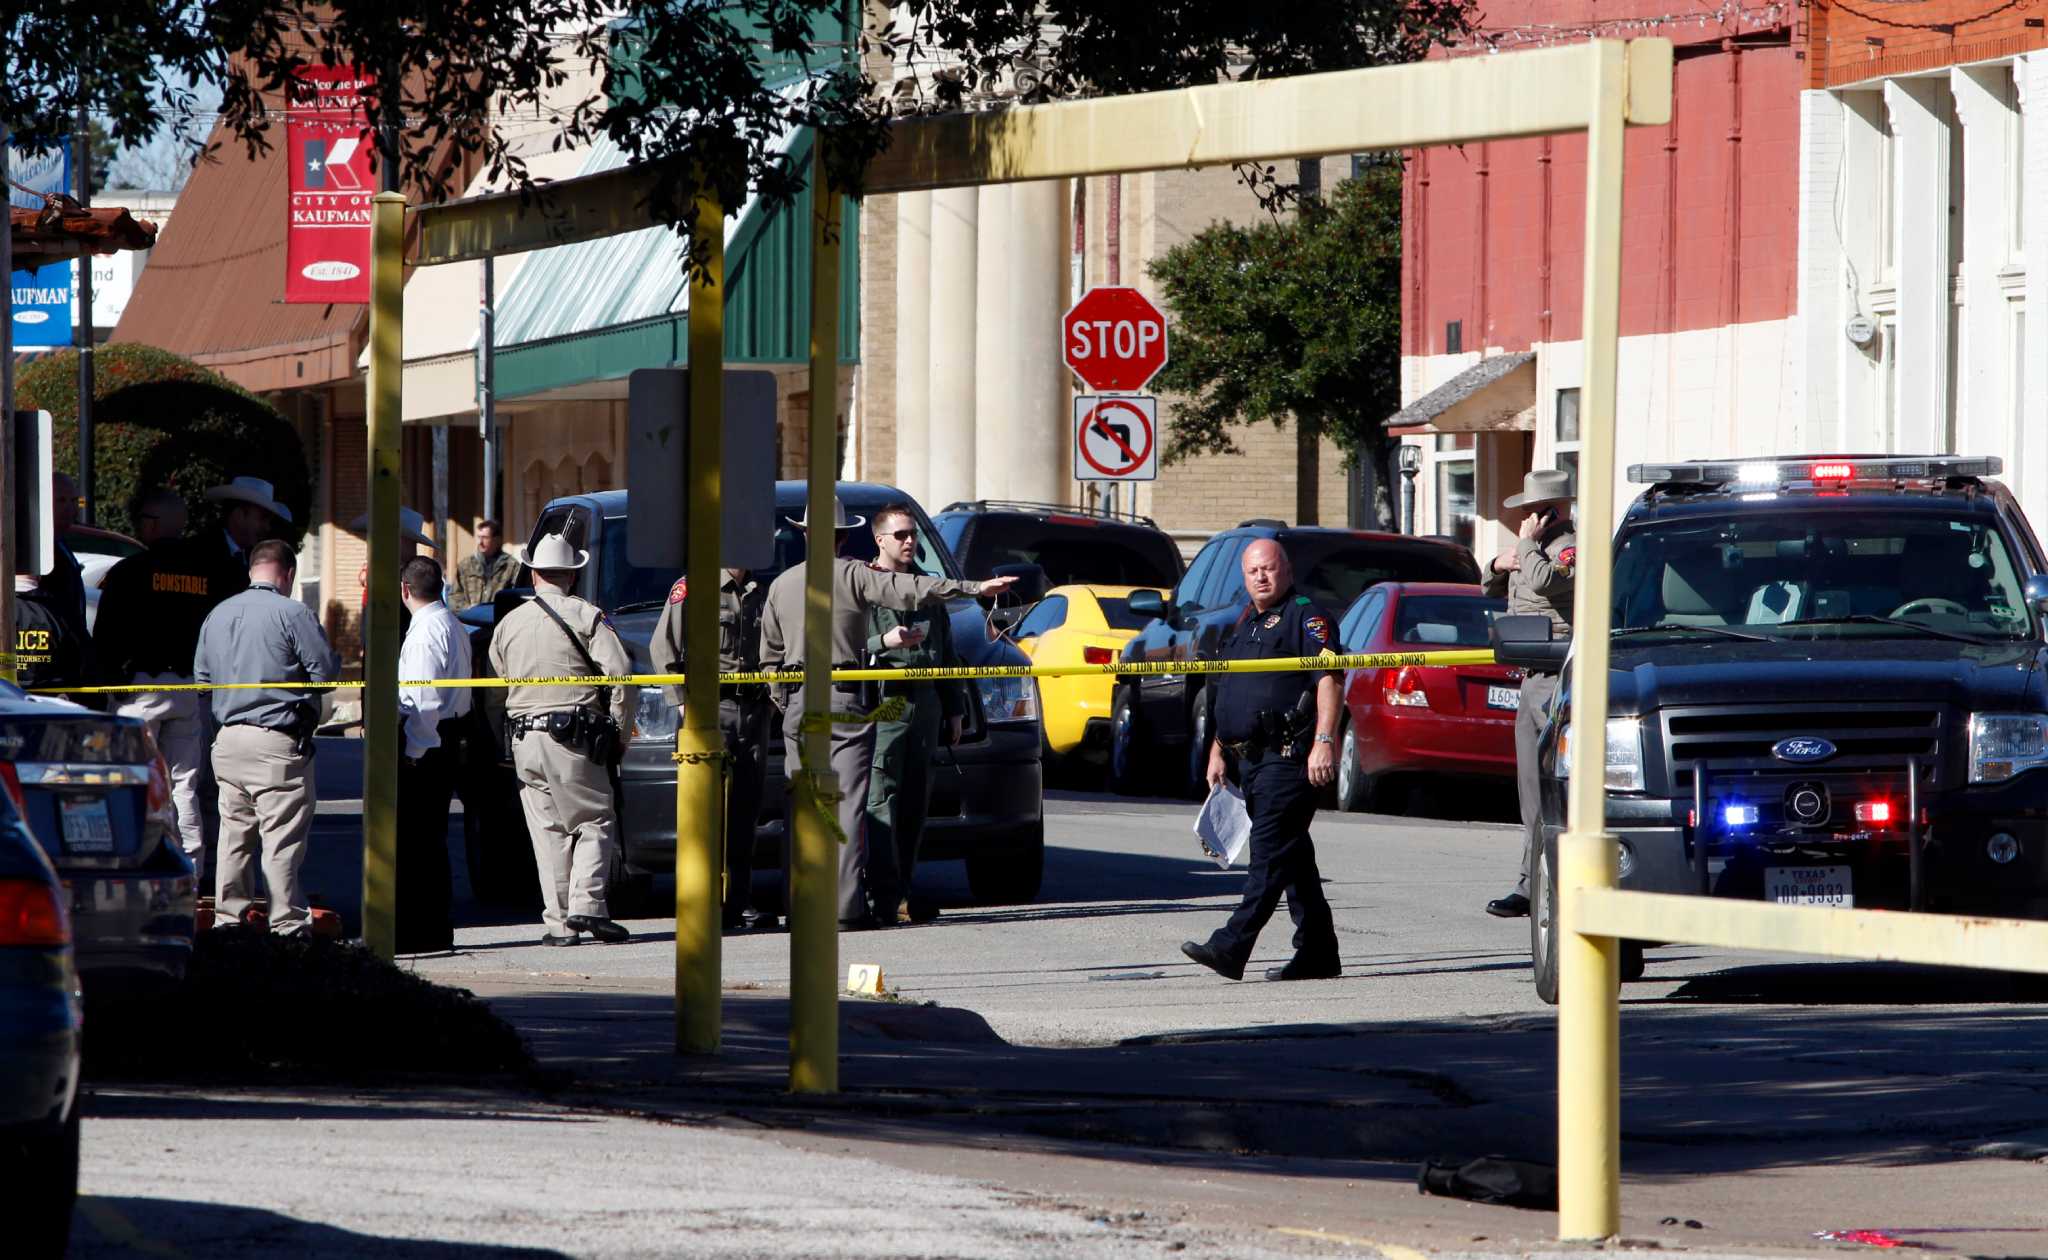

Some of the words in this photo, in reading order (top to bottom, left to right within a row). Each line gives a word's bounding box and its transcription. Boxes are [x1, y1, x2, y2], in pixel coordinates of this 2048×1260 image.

[293, 196, 338, 206] CITY
[293, 209, 371, 223] KAUFMAN
[11, 287, 69, 305] AUFMAN
[1071, 320, 1160, 359] STOP
[152, 572, 208, 596] CONSTABLE
[16, 630, 49, 650] ICE
[1201, 660, 1230, 671] CRIME
[1299, 657, 1330, 669] CROSS
[1334, 656, 1350, 668] NOT
[1352, 656, 1365, 668] DO
[1369, 654, 1397, 667] SCENE
[1400, 653, 1426, 666] CRIME
[1102, 663, 1132, 673] CROSS
[1136, 662, 1153, 673] NOT
[1155, 662, 1168, 673] DO
[1172, 661, 1199, 672] SCENE
[1786, 740, 1822, 755] Ford
[1792, 870, 1826, 879] TEXAS
[858, 968, 868, 992] 2
